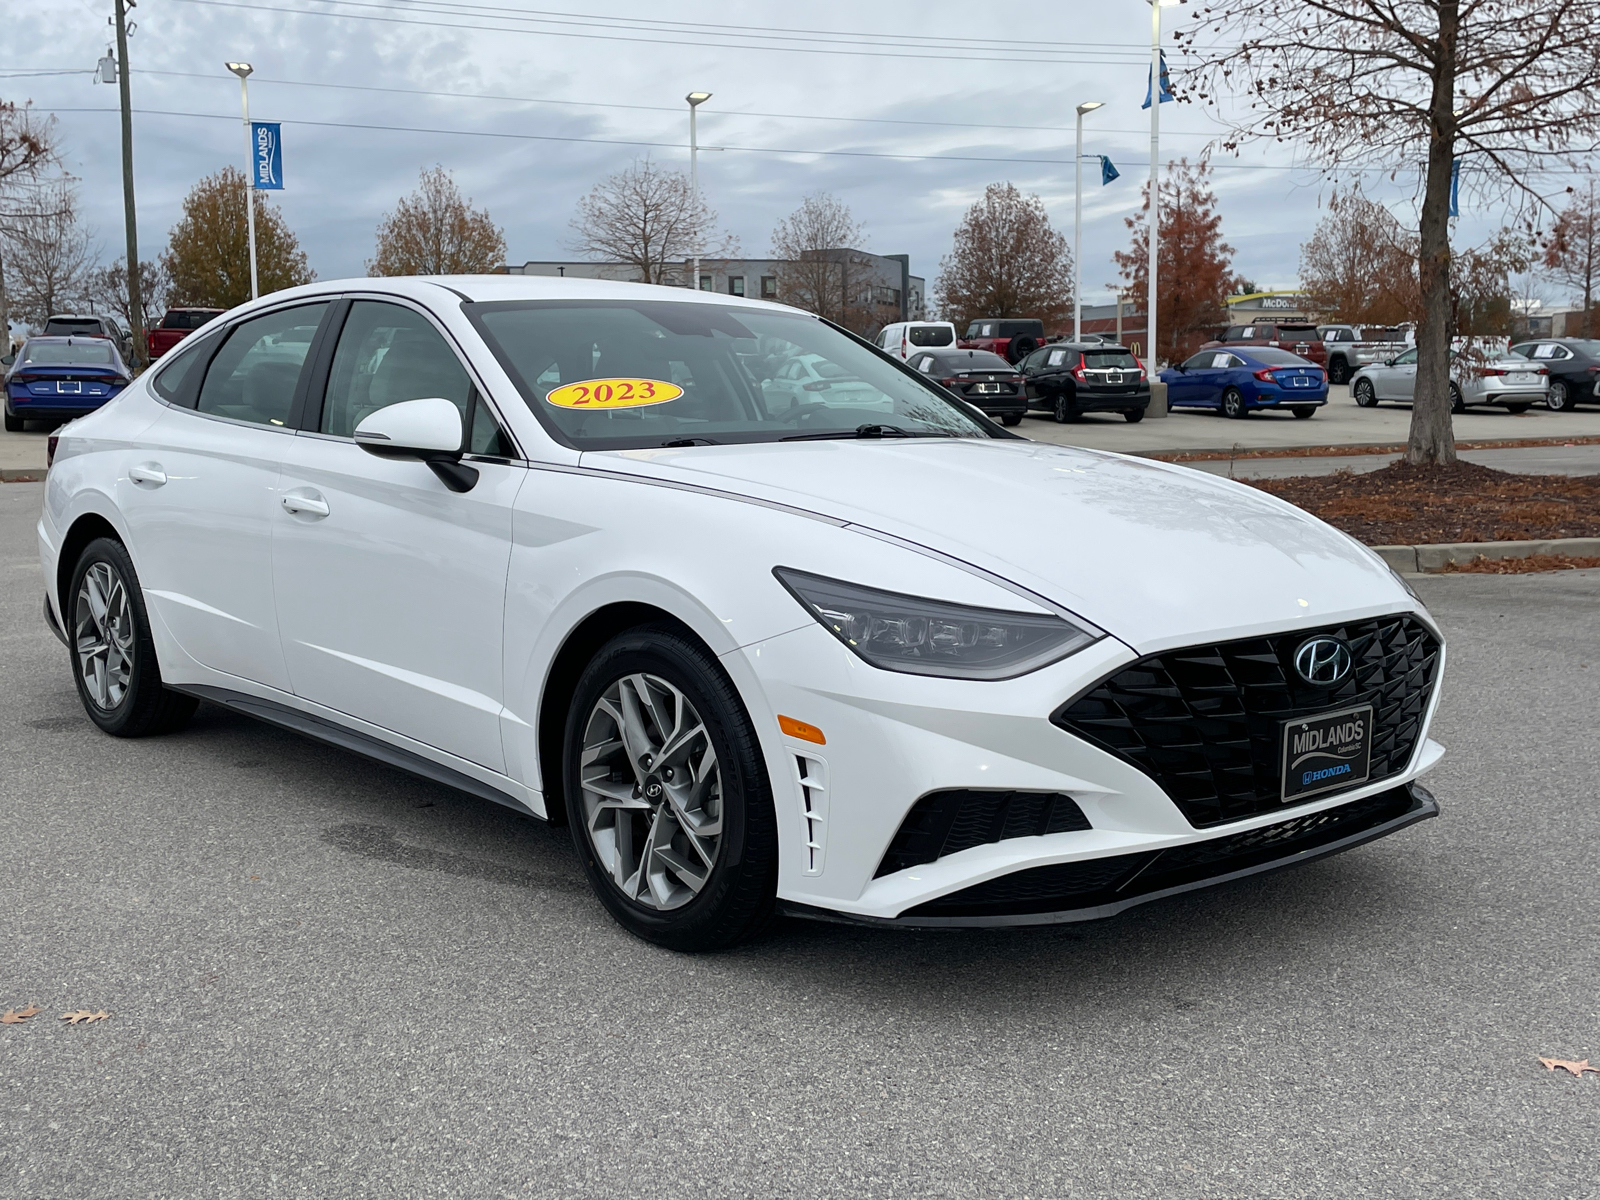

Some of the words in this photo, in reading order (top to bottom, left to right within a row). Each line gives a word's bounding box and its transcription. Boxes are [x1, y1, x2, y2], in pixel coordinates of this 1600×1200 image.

[257, 127, 269, 183] MIDLANDS
[572, 382, 656, 405] 2023
[1293, 720, 1364, 754] MIDLANDS
[1312, 764, 1351, 780] HONDA
